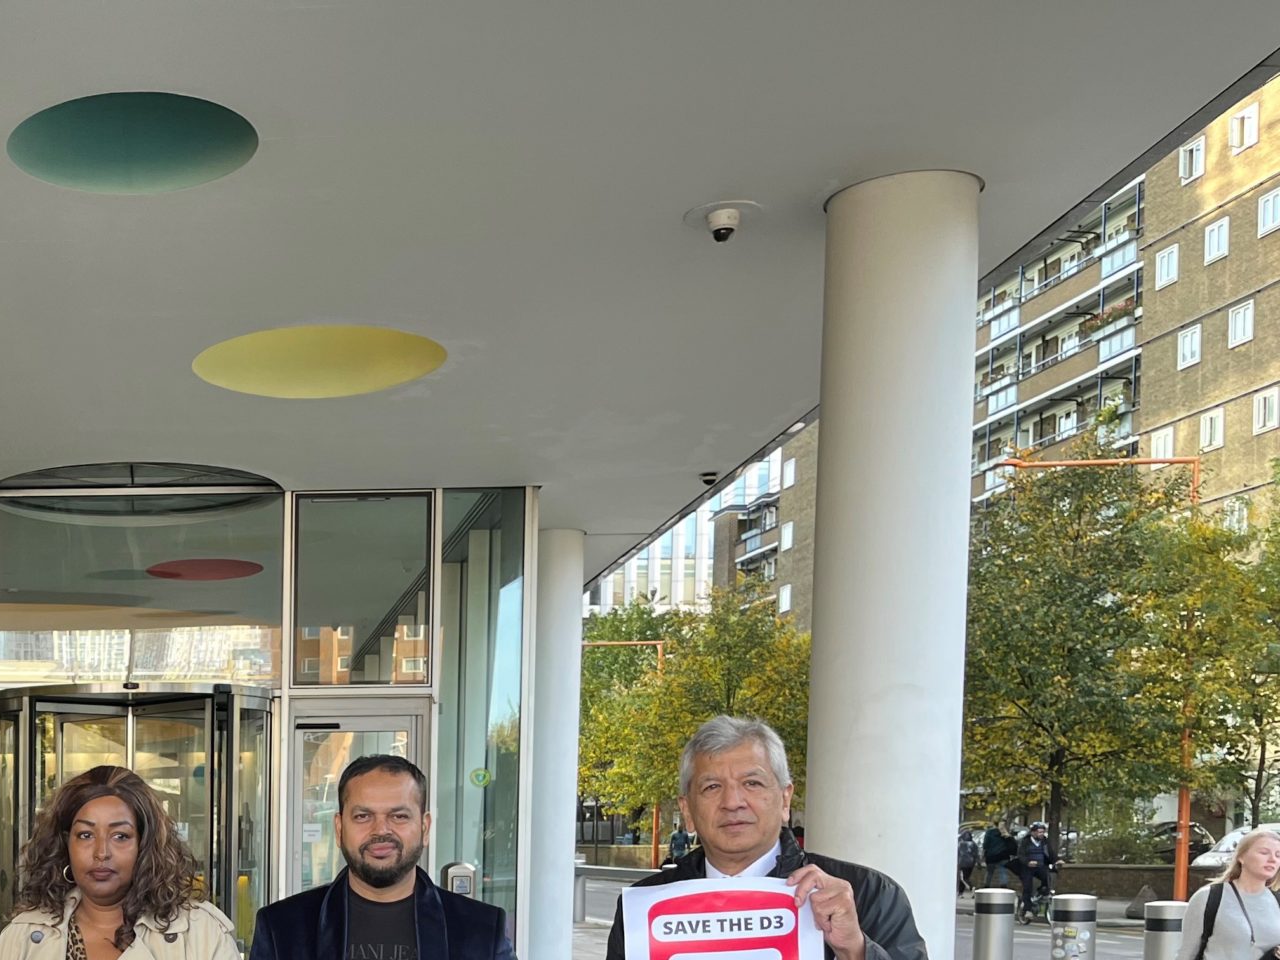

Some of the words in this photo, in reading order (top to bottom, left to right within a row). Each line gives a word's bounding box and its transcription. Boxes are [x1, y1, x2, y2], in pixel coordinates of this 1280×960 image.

[662, 919, 712, 936] SAVE
[717, 916, 753, 933] THE
[760, 914, 784, 930] D3
